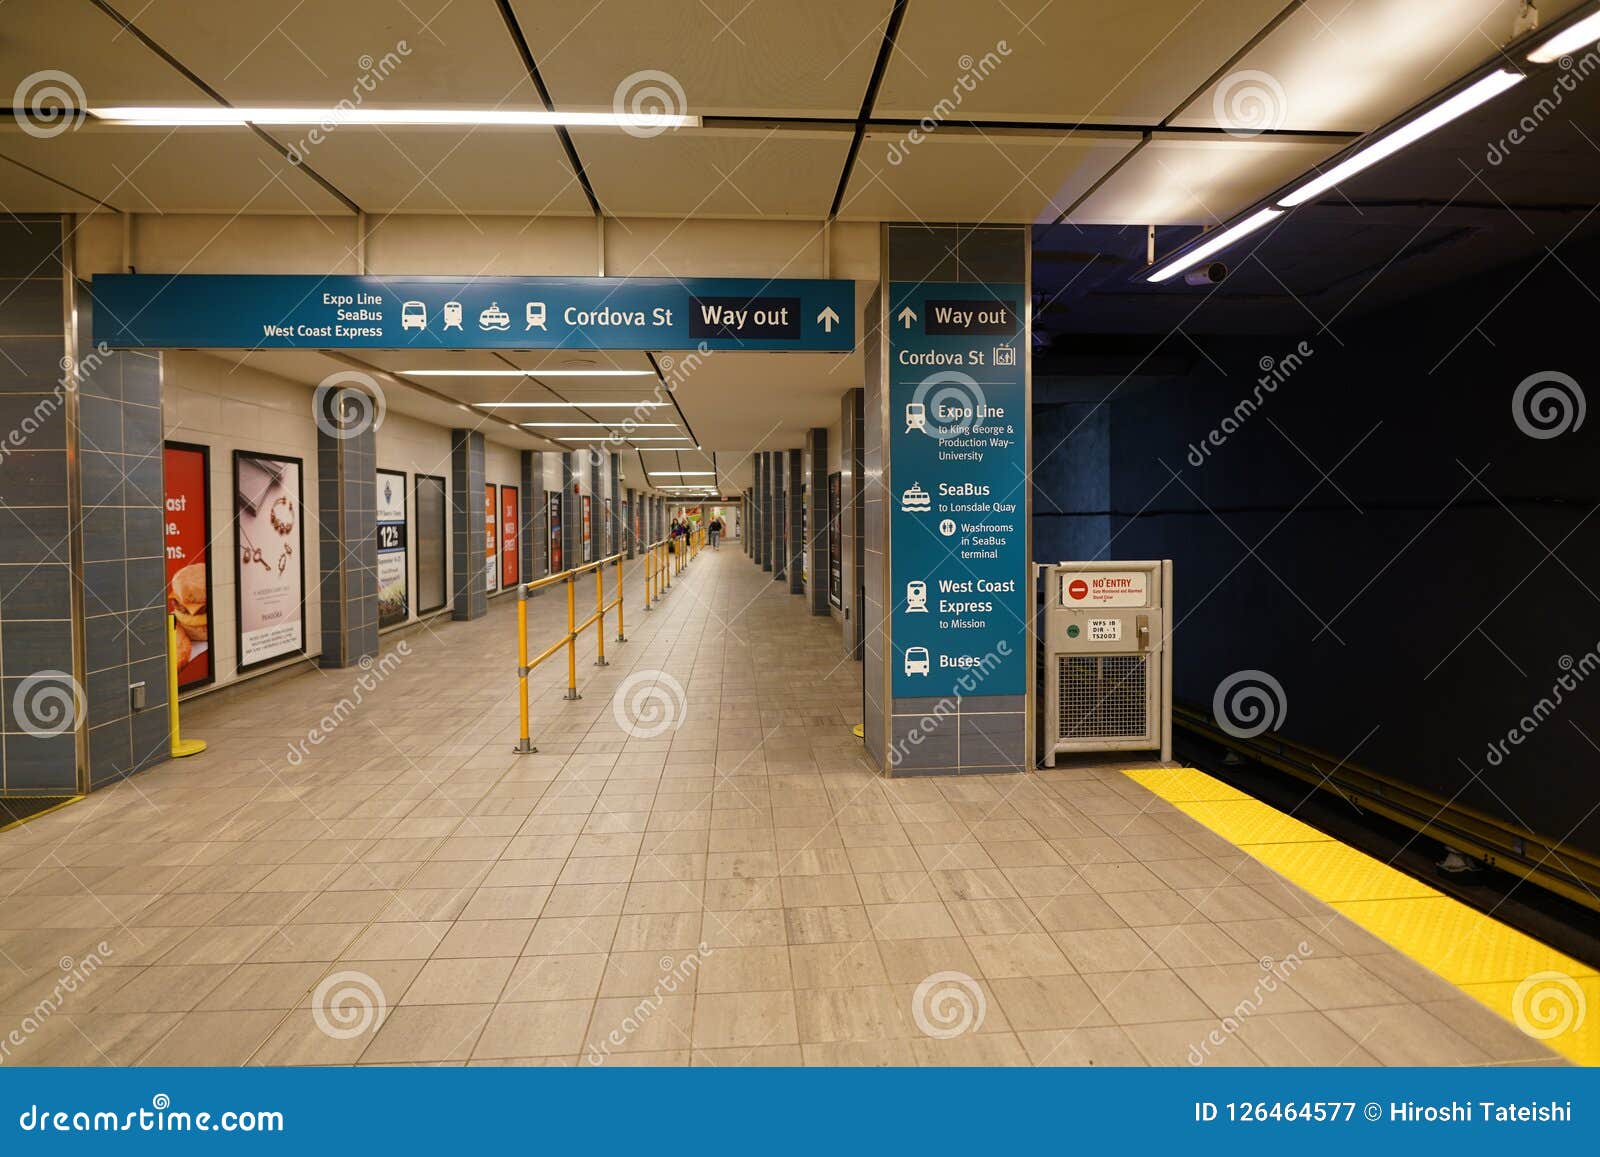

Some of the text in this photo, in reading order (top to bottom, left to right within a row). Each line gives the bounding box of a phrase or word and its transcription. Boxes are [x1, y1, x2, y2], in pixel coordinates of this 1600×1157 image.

[323, 293, 383, 307] Expo Line
[337, 309, 383, 321] SeaBus
[564, 305, 789, 331] Cordova St Way out
[935, 307, 1007, 328] Way out
[263, 325, 383, 340] West Coast Express
[899, 350, 985, 366] Cordova St
[938, 404, 1004, 422] Expo Line
[938, 424, 1015, 436] to King George &
[938, 438, 987, 448] Production
[938, 451, 984, 463] University
[938, 483, 990, 497] SeaBus
[165, 494, 186, 512] ast
[938, 502, 1016, 514] to Lonsdale Quay
[961, 523, 1014, 533] Washrooms
[961, 536, 1006, 546] in SeaBus
[961, 549, 998, 560] terminal
[938, 579, 1015, 593] West Coast
[1092, 578, 1132, 588] NO ENTRY
[939, 600, 993, 616] Express
[939, 619, 986, 629] to Mission
[939, 655, 981, 668] Buses
